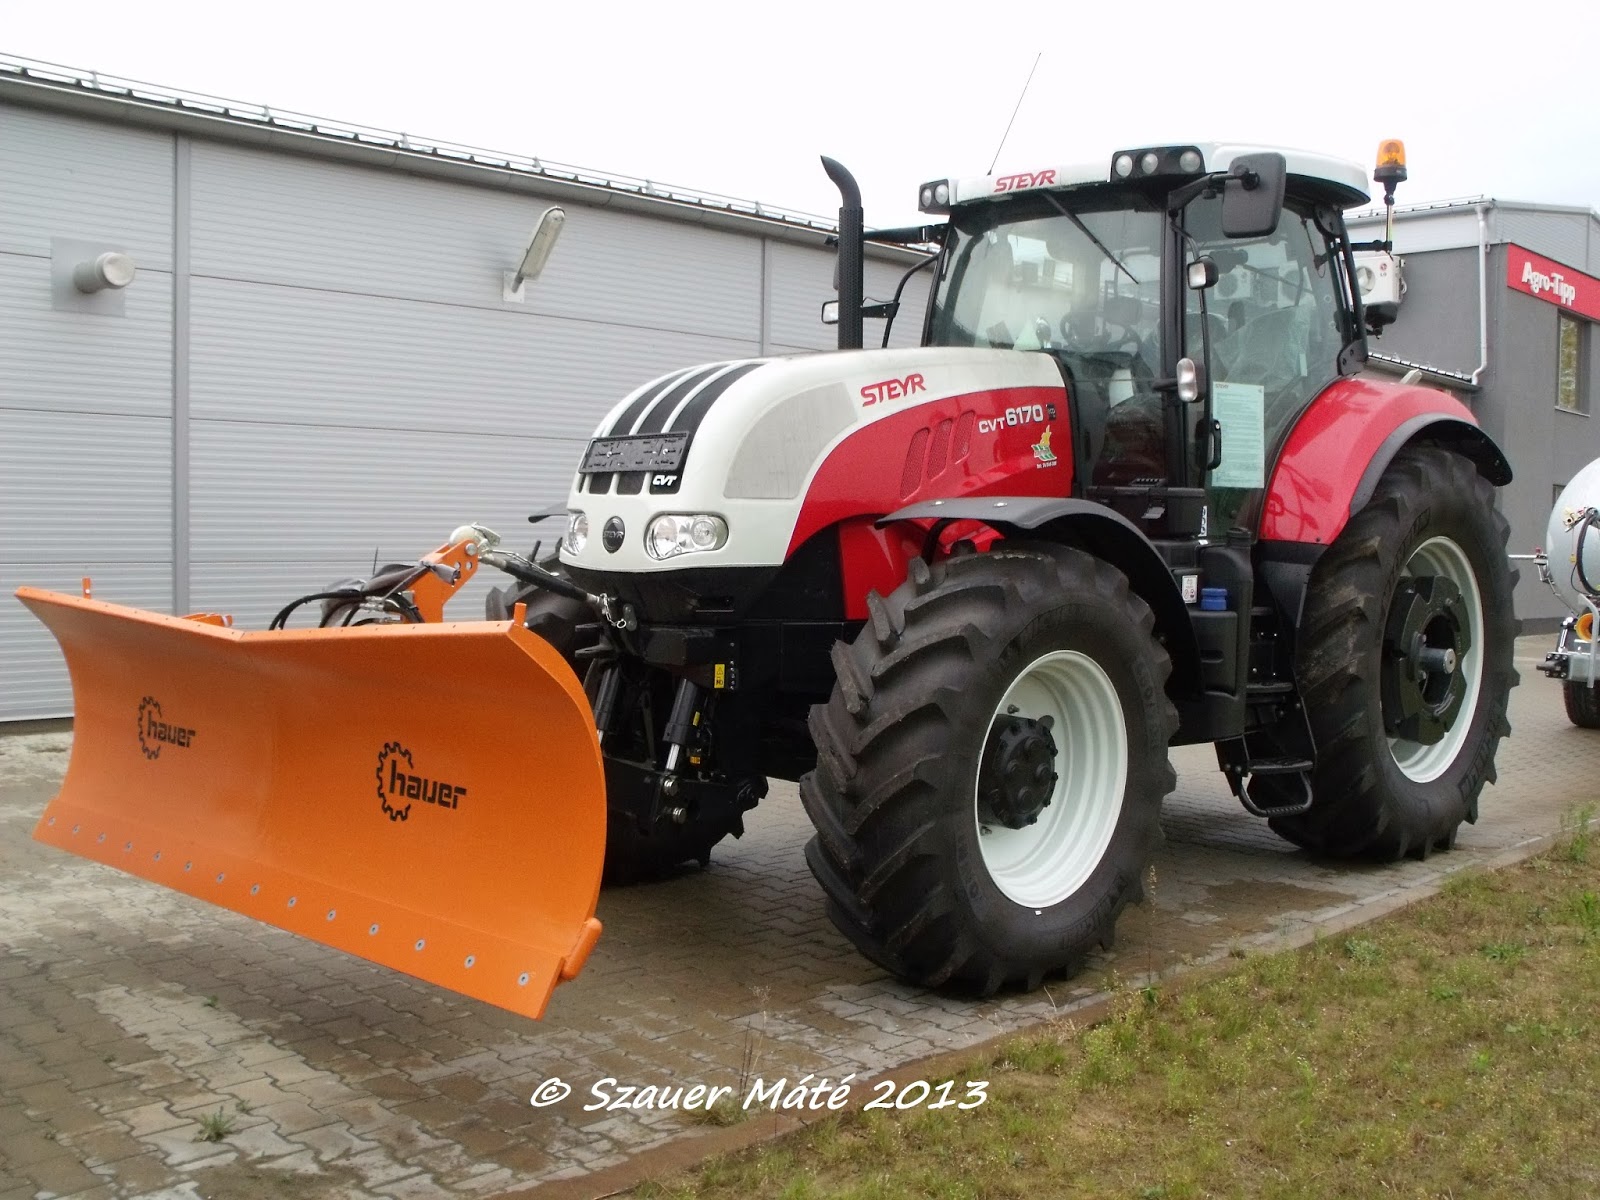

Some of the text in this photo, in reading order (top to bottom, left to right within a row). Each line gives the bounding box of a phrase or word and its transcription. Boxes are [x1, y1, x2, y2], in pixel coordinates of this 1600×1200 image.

[994, 169, 1056, 193] STEYR
[1521, 261, 1576, 307] Agro-Tipp
[860, 373, 927, 407] STEYR
[978, 404, 1044, 434] CVT 6170
[652, 474, 677, 486] CVT
[147, 710, 196, 749] hauer
[389, 759, 467, 810] hauer
